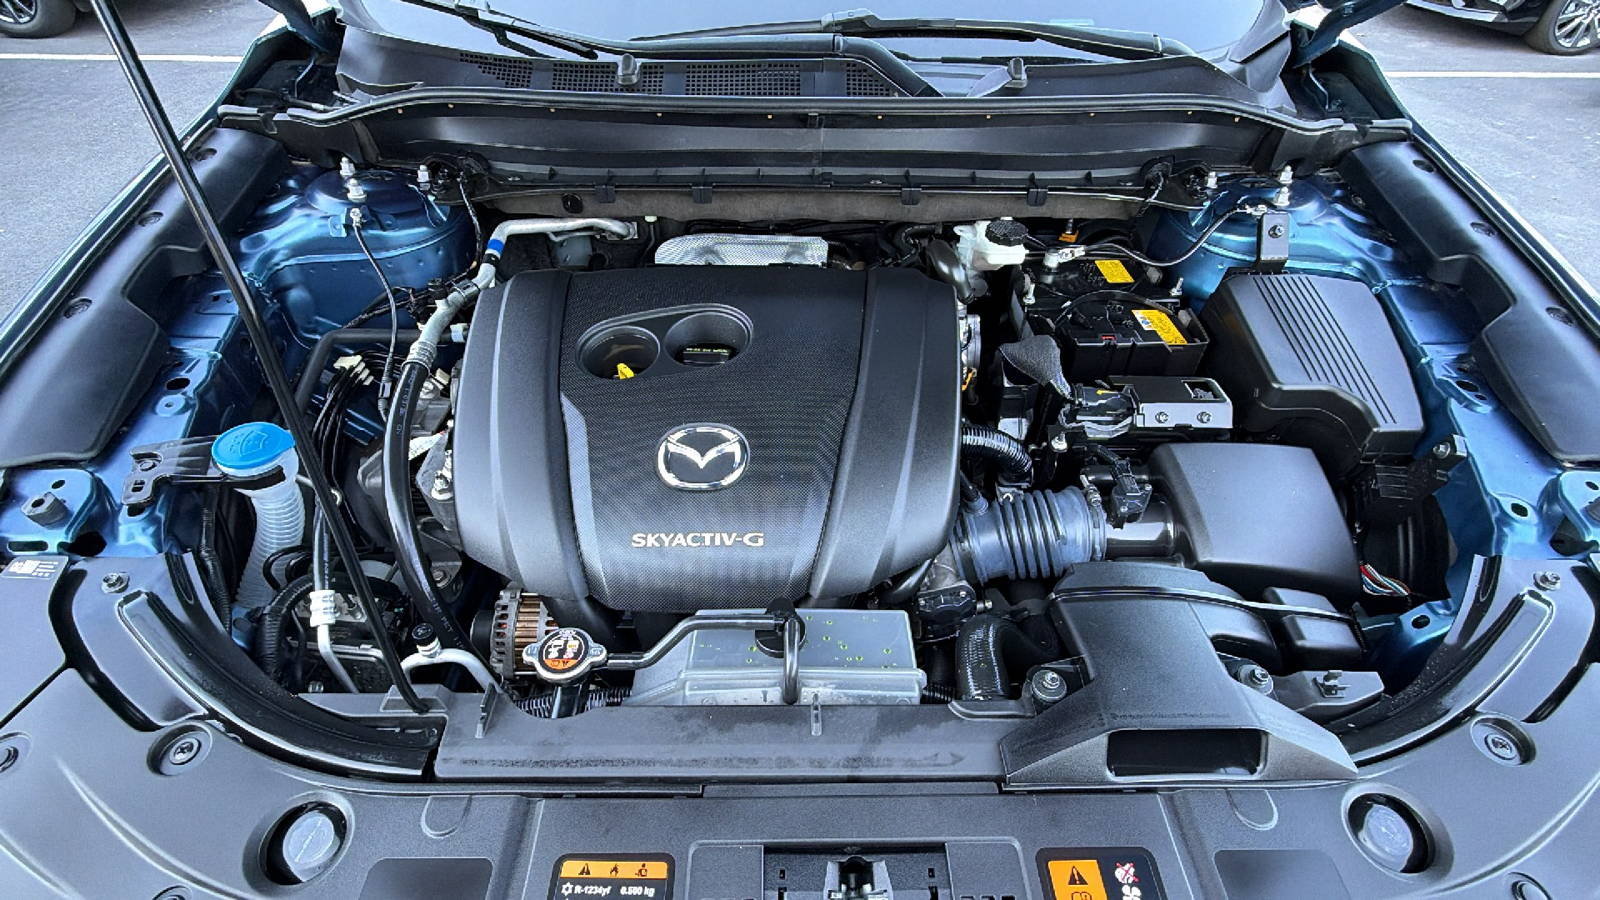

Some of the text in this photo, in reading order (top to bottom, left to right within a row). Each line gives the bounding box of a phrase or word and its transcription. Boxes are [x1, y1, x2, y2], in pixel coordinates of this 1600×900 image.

[631, 532, 764, 547] SKYACTIV-G
[574, 885, 612, 897] R-1234yf
[644, 886, 655, 897] kg
